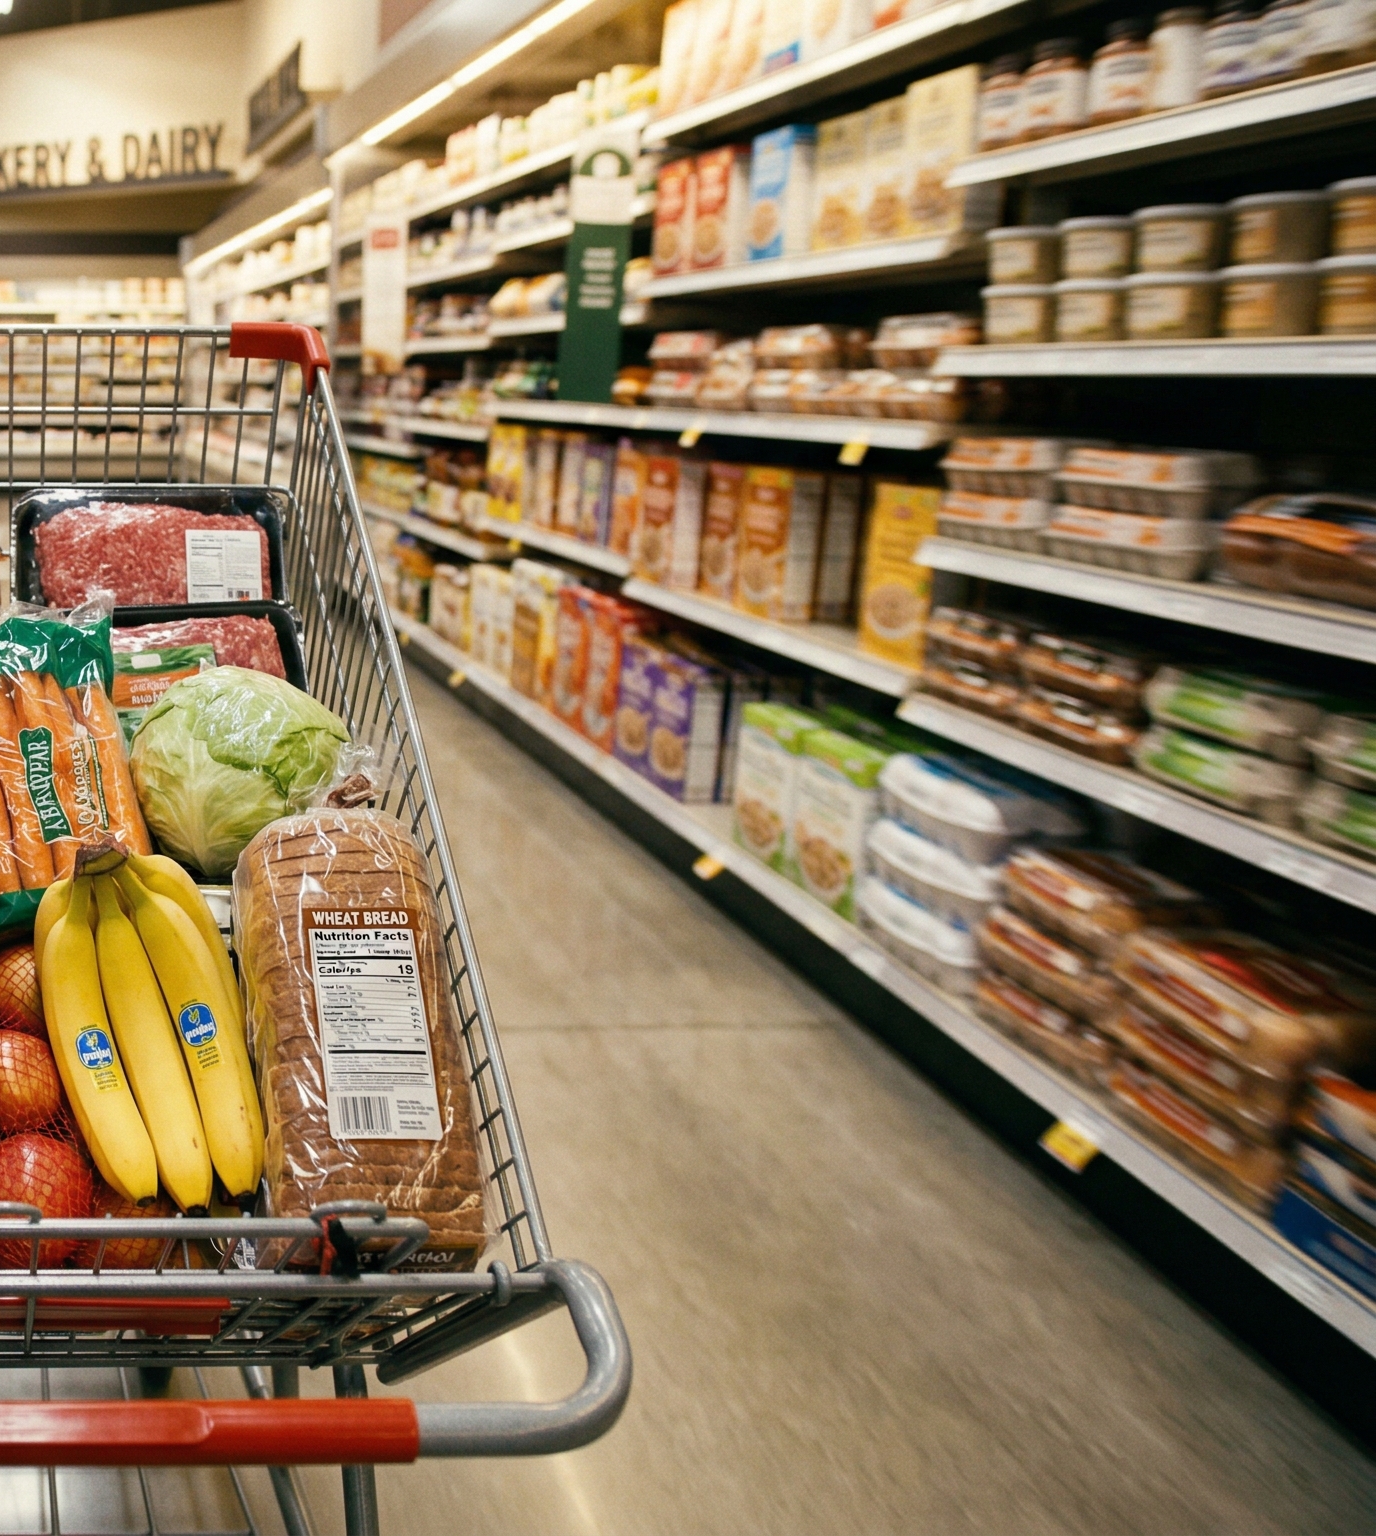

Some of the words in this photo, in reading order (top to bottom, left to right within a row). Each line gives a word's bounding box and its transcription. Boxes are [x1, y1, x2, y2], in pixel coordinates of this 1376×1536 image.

[87, 136, 107, 181] &
[123, 123, 224, 178] DAIRY
[312, 911, 359, 926] WHEAT
[363, 911, 409, 926] BREAD
[314, 931, 370, 941] Nutrition
[374, 931, 409, 941] Facts
